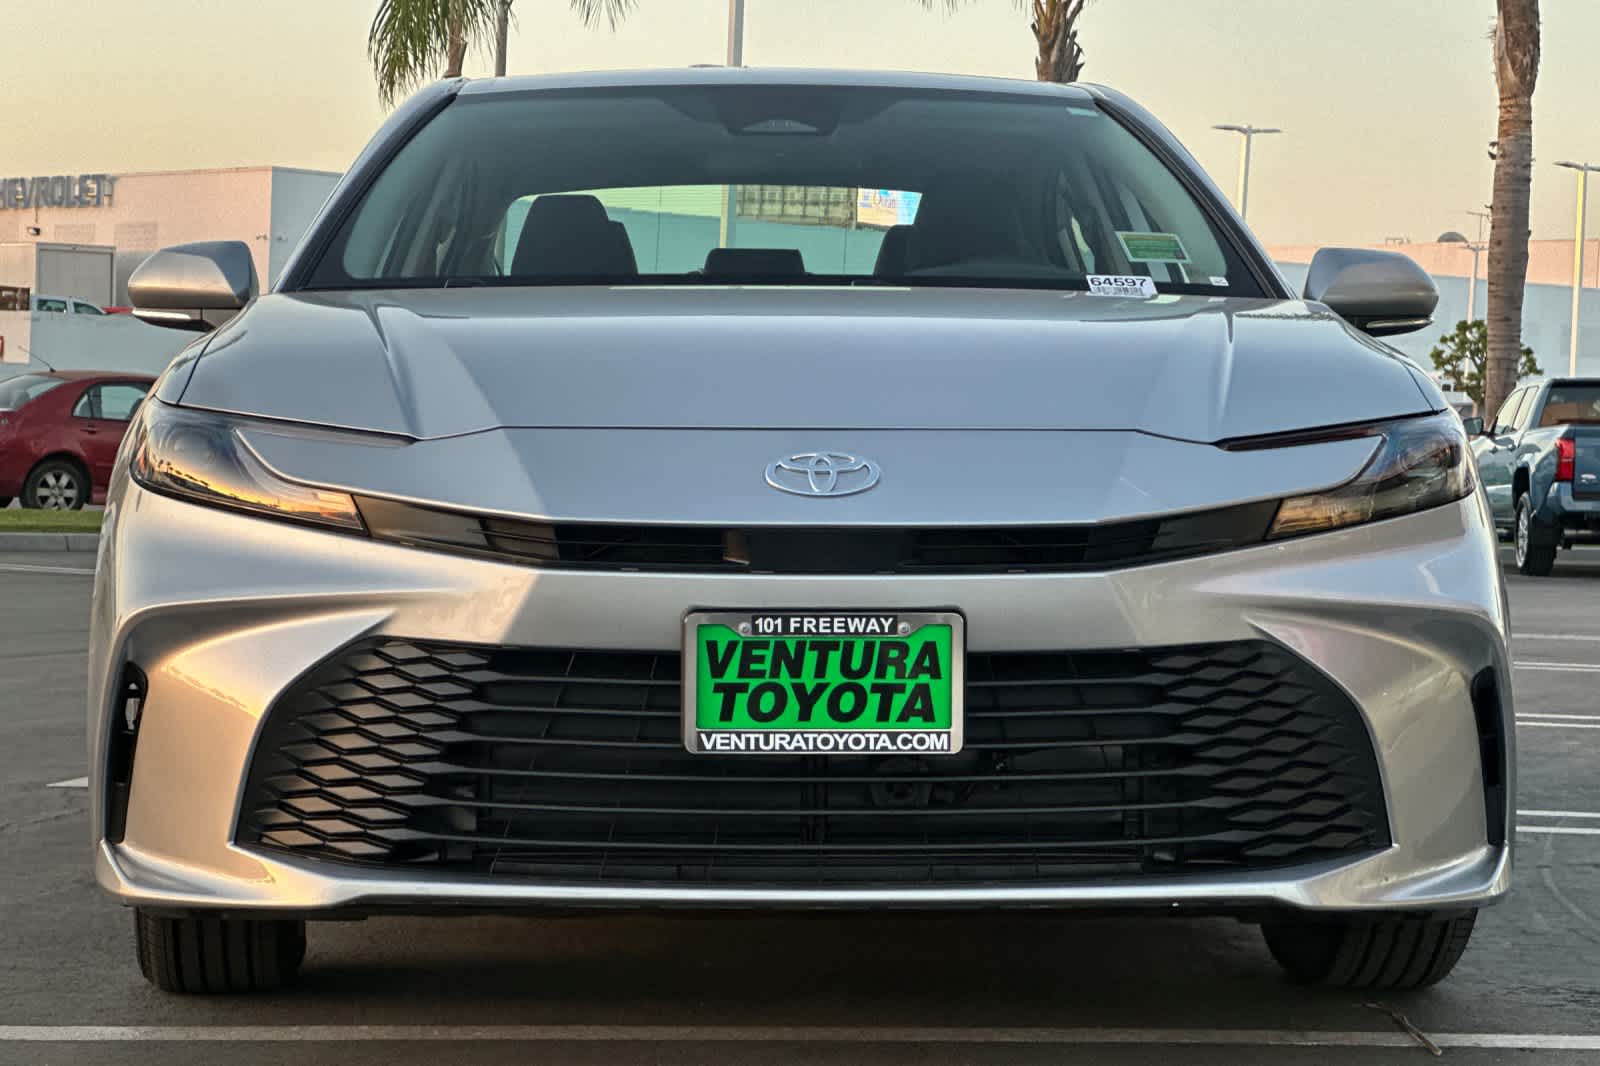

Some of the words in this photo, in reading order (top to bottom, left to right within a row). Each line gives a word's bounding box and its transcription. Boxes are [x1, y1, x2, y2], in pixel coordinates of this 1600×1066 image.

[1090, 277, 1147, 287] 64597
[754, 617, 783, 633] 101
[790, 617, 894, 633] FREEWAY
[705, 640, 942, 680] VENTURA
[712, 682, 936, 722] TOYOTA
[700, 733, 948, 750] VENTURATOYOTA.COM
